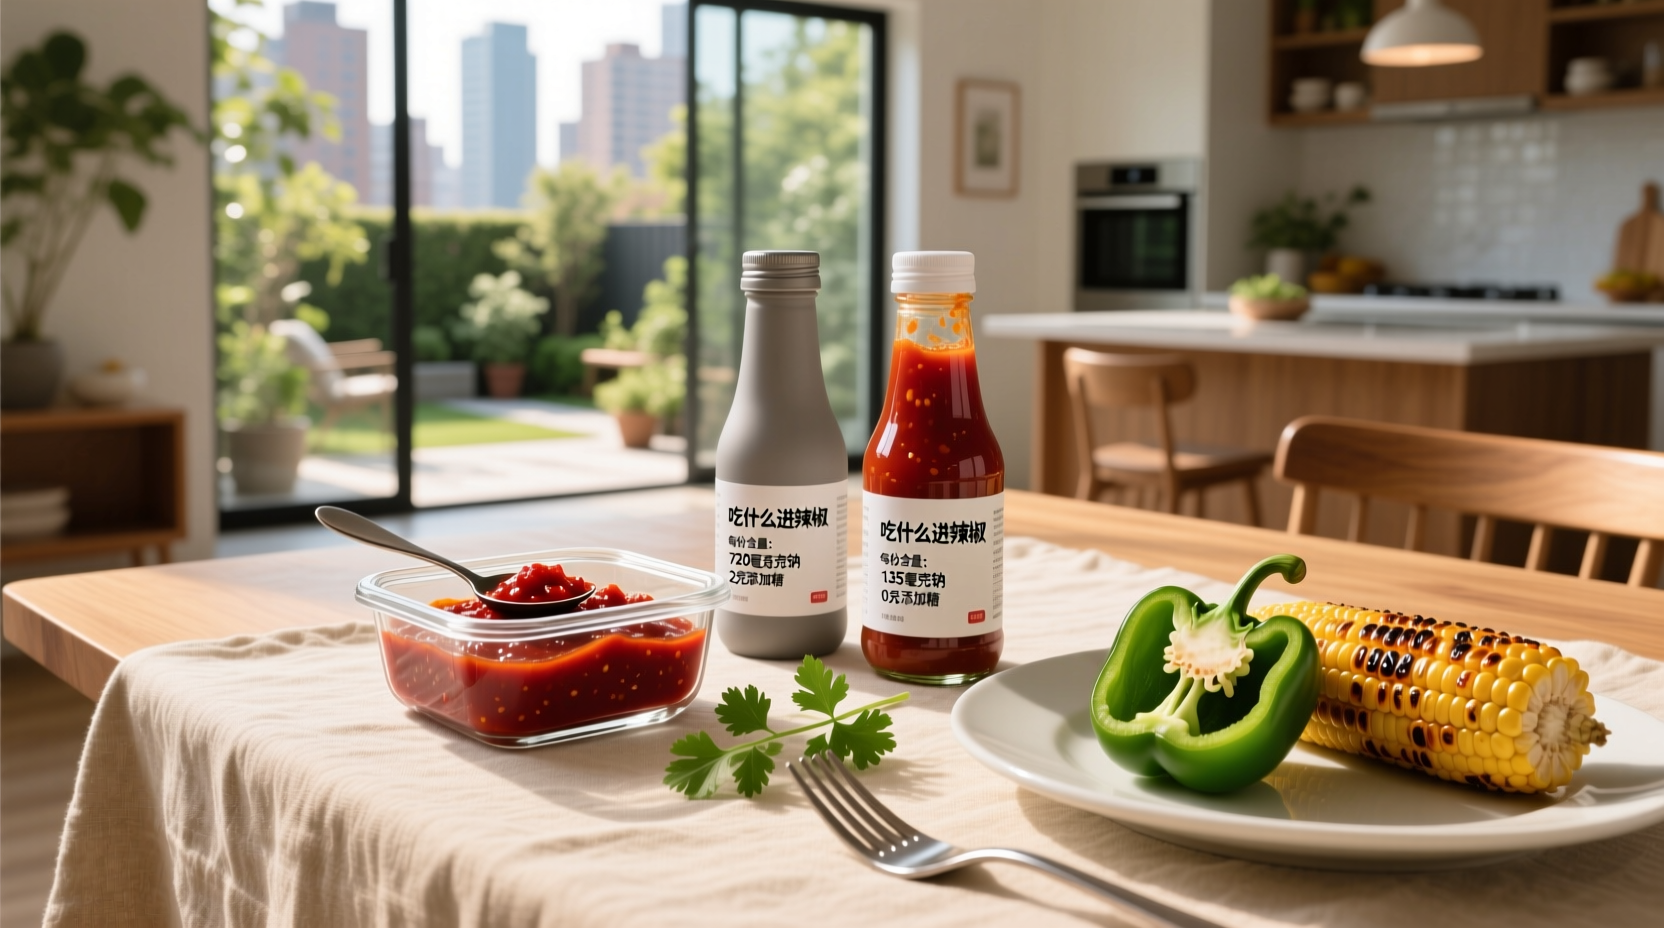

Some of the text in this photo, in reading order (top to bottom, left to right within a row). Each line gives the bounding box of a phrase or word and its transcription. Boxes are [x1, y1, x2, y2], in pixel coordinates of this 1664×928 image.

[880, 519, 987, 544] 吃什么进辣椒
